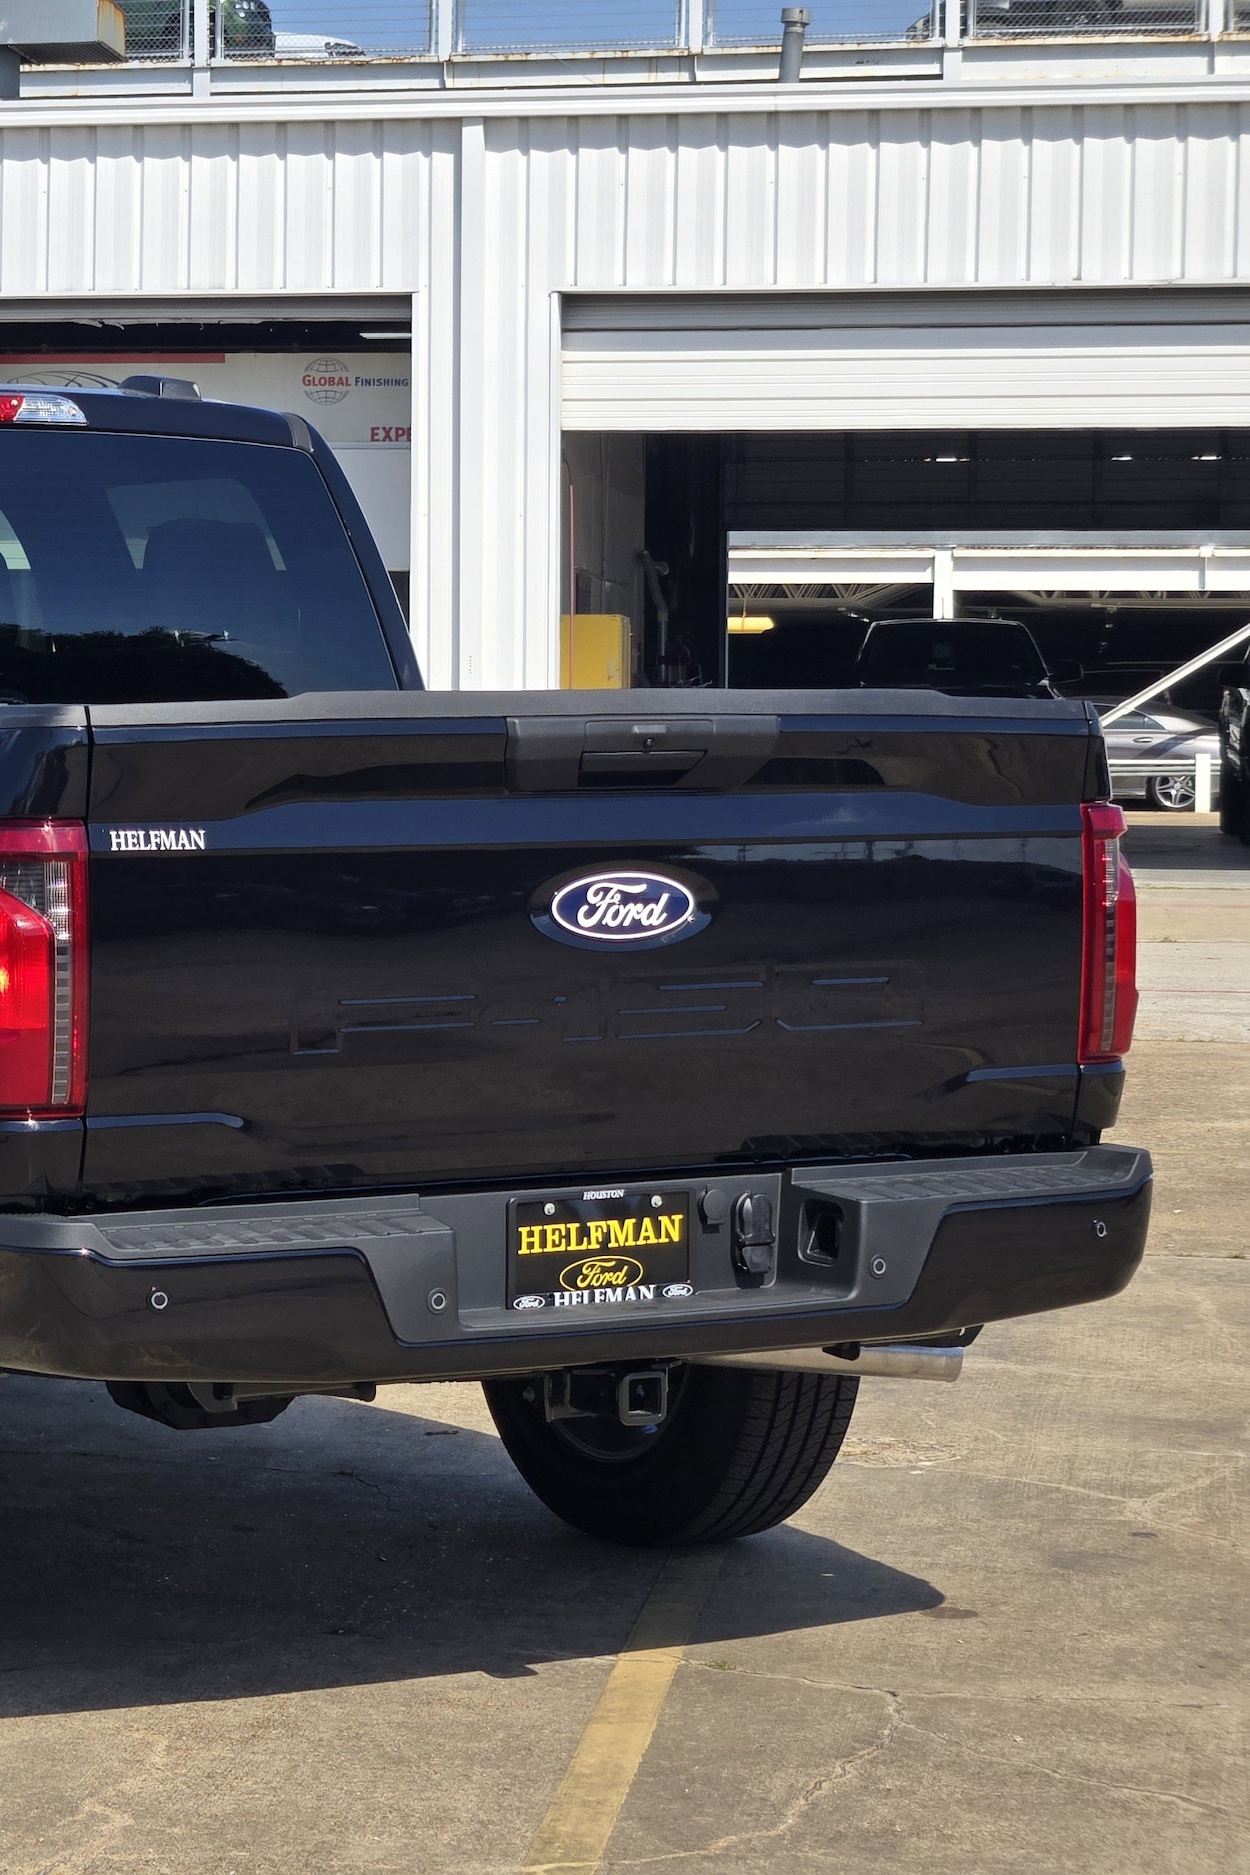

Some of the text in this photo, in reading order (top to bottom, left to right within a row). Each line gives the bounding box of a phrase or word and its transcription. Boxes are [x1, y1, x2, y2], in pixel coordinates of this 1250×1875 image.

[302, 375, 409, 387] GLOBAL FINISHING
[110, 829, 206, 851] HELFMAN
[577, 882, 670, 928] Ford
[583, 1189, 625, 1200] HOUSTON
[518, 1214, 683, 1255] HELFMAN
[576, 1260, 629, 1288] Ford
